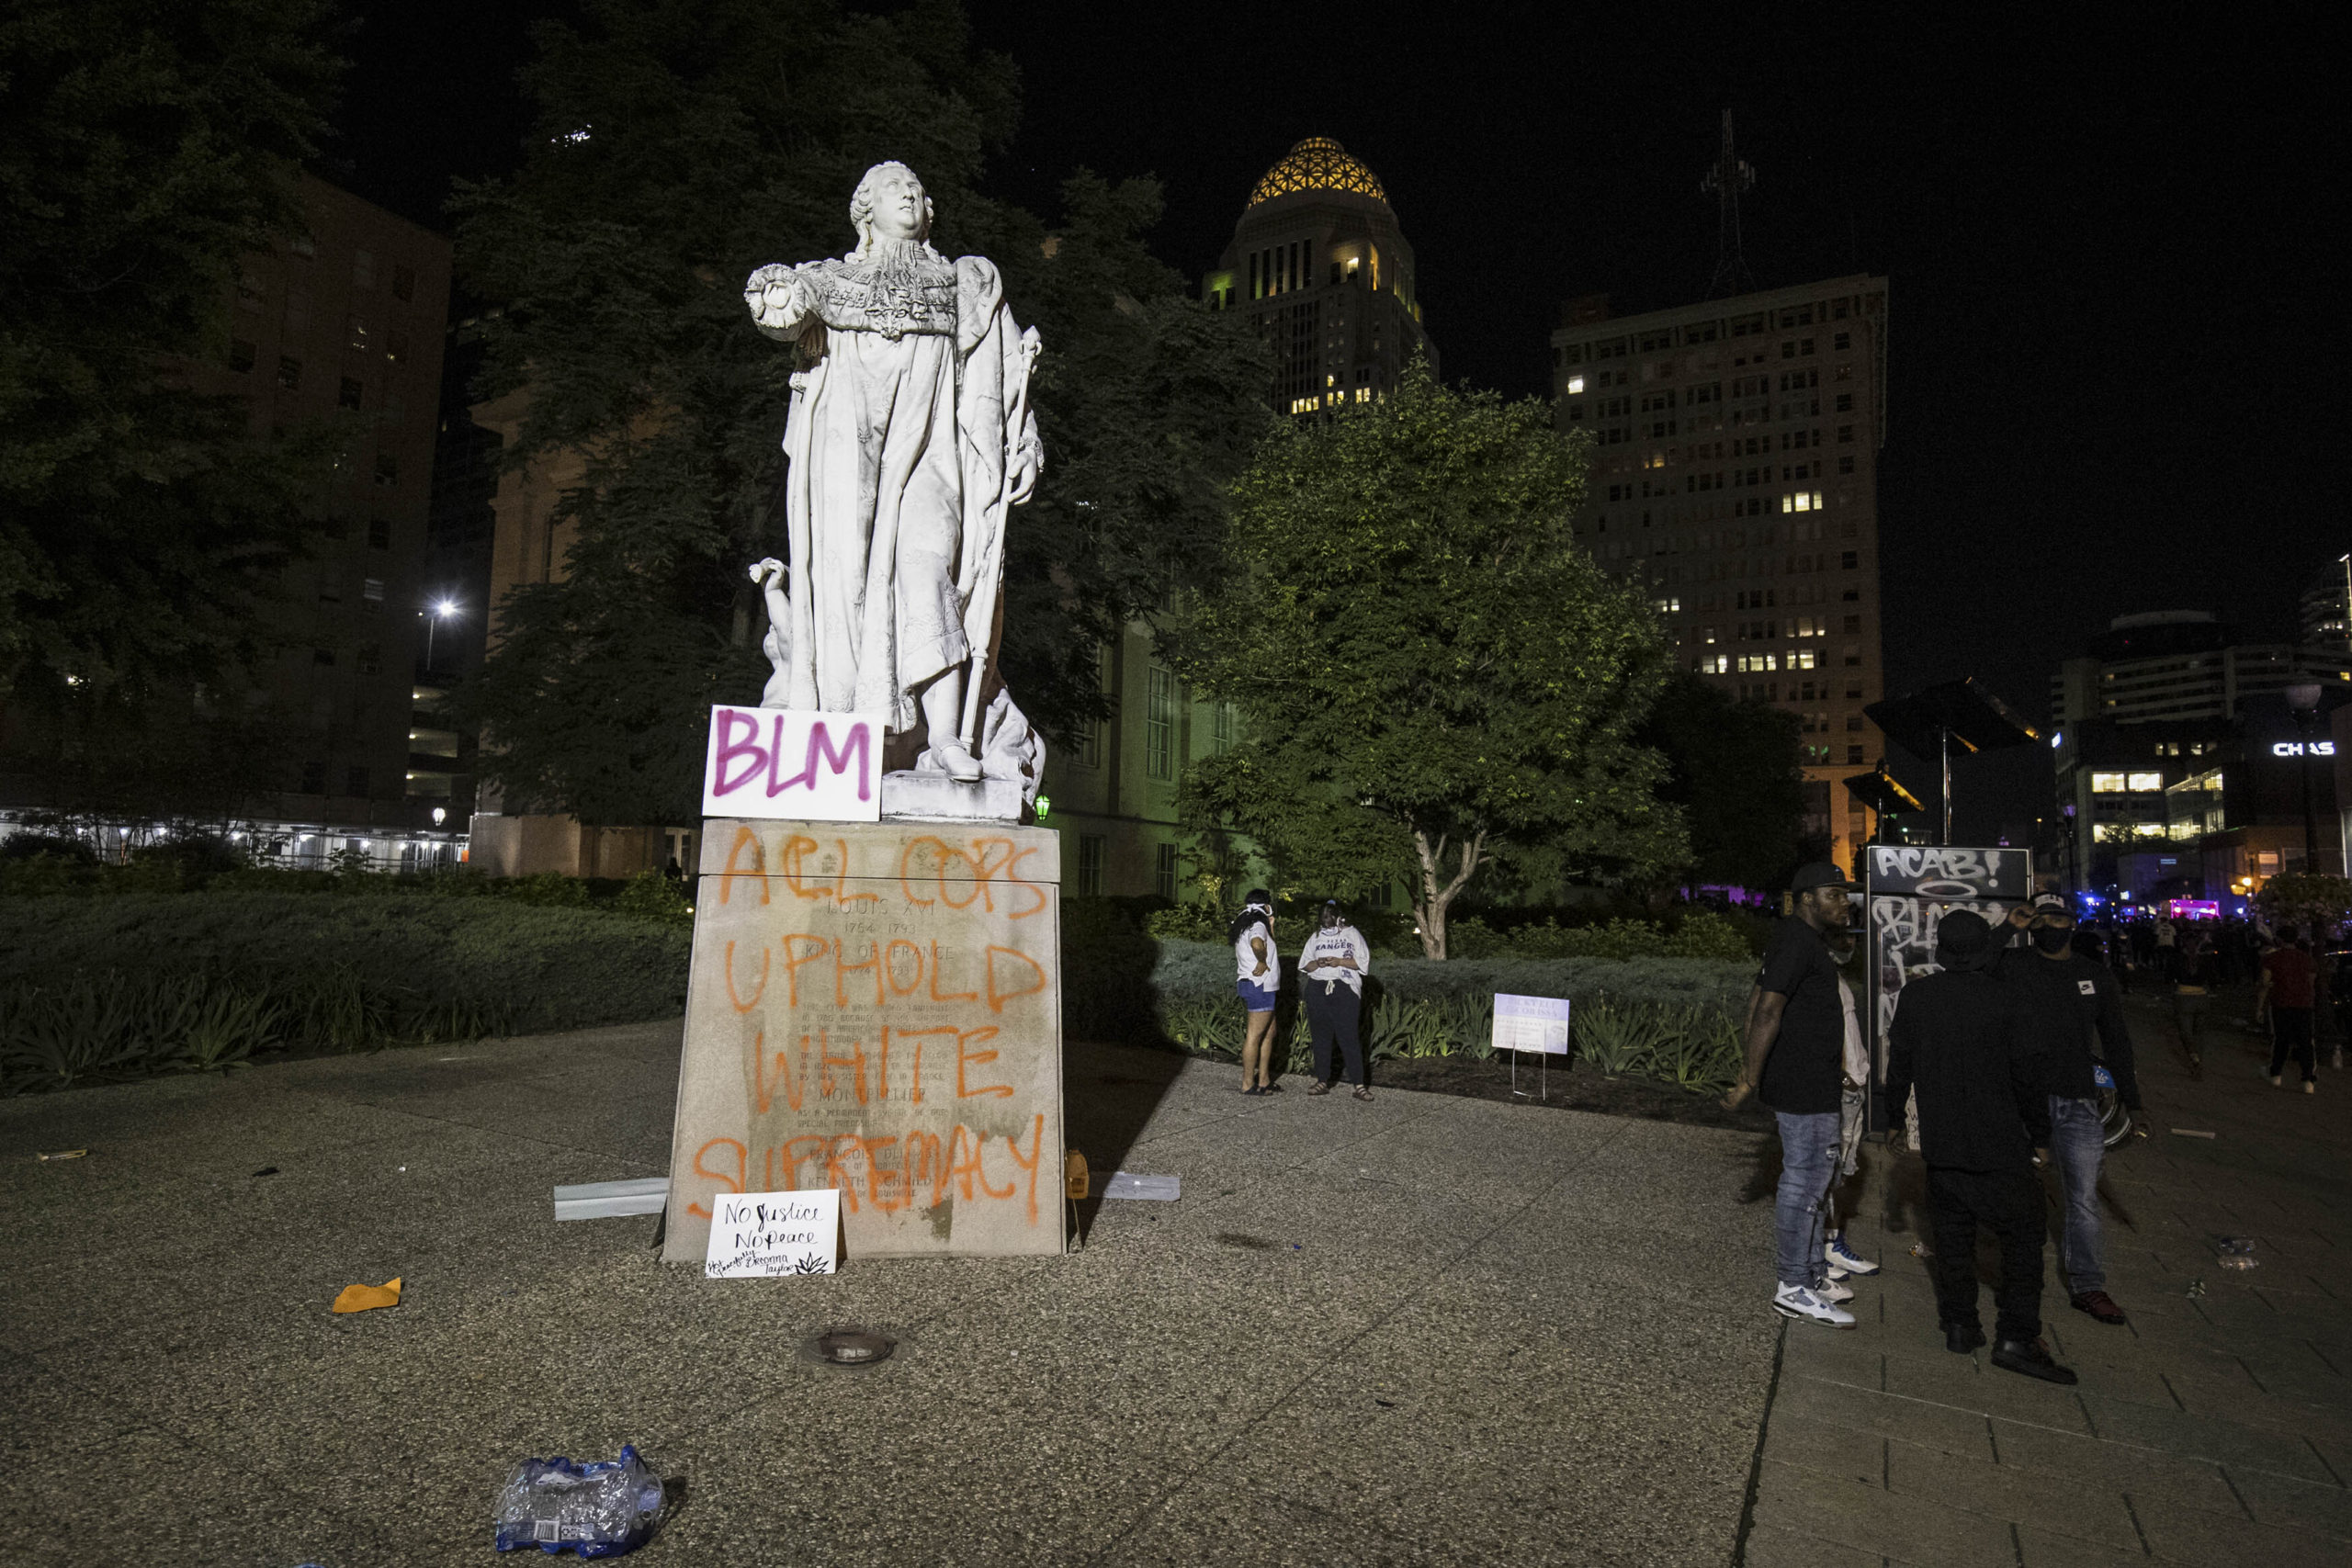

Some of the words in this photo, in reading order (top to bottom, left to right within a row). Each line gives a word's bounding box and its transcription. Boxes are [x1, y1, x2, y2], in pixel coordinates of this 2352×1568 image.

[713, 709, 871, 801] BLM
[720, 826, 878, 906] ALL
[901, 835, 1046, 919] COPS
[1876, 848, 2001, 888] ACAB!
[827, 897, 889, 916] LOUIS
[903, 898, 936, 916] XVI
[844, 923, 876, 934] 1754
[888, 923, 917, 935] 1793
[806, 943, 843, 958] KING
[857, 944, 878, 959] OF
[891, 945, 956, 960] FRANCE
[725, 933, 1046, 1014] UPHOLD
[755, 1025, 1014, 1113] WHITE
[687, 1114, 1045, 1227] SUPREMACY
[808, 1175, 865, 1188] KENNETH
[725, 1198, 752, 1224] No
[735, 1229, 763, 1249] No
